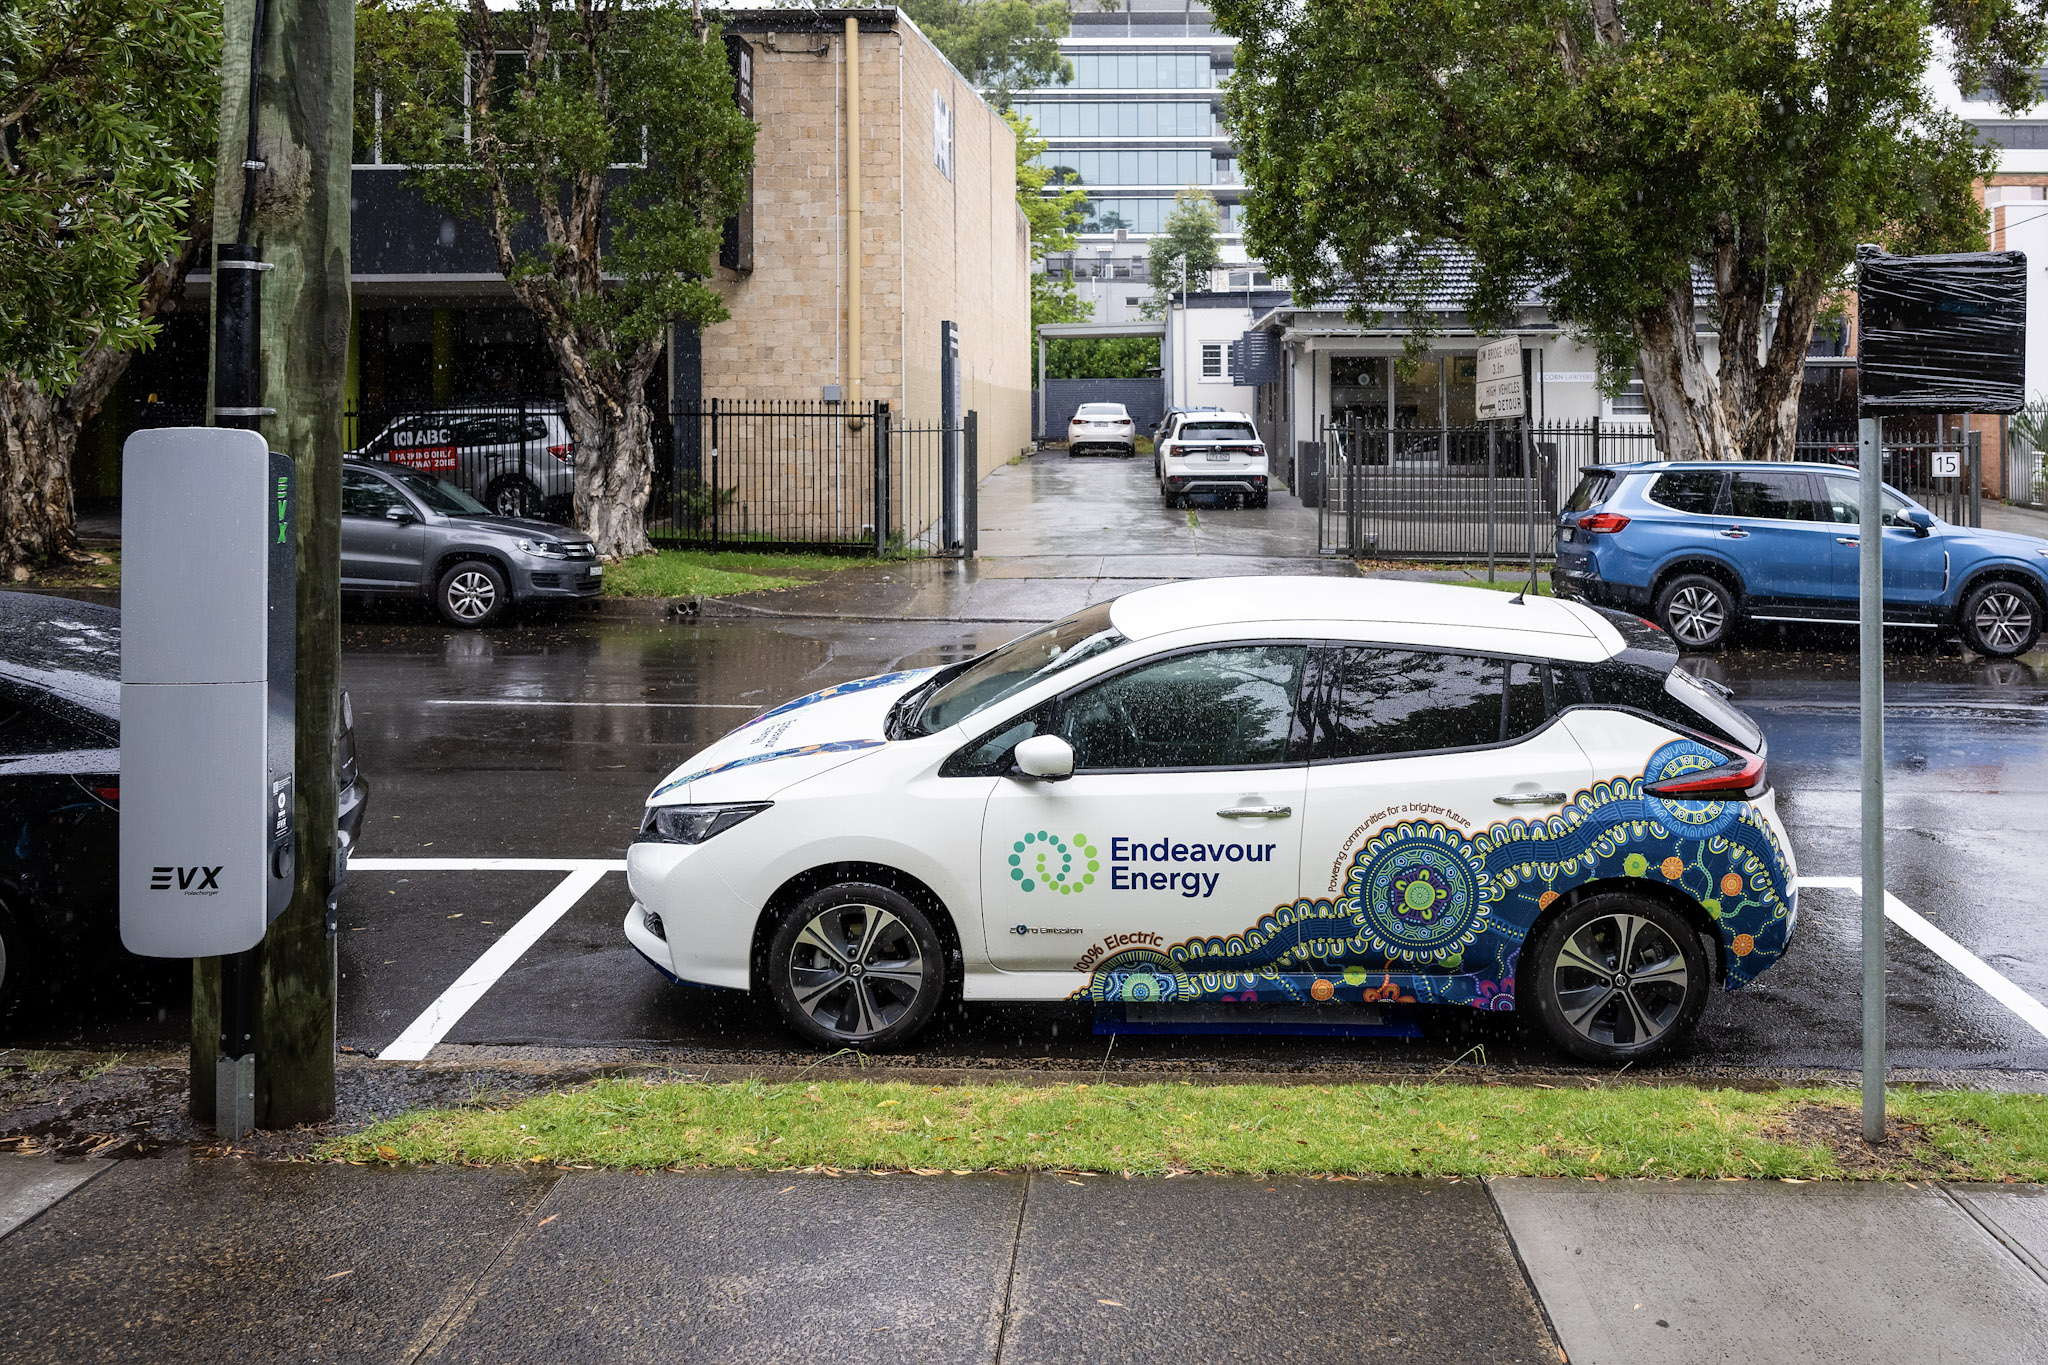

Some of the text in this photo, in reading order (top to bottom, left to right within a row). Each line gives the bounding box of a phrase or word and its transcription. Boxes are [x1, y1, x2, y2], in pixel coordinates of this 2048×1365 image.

[1487, 346, 1502, 360] BRIDGE
[1504, 342, 1519, 357] AHEAD
[1486, 381, 1520, 397] HIGH VEHICLES
[1498, 397, 1521, 411] DETOUR
[415, 429, 451, 446] ABC
[395, 450, 452, 461] PARKING ONLY
[434, 458, 456, 467] ZONE
[1936, 456, 1956, 473] 15
[277, 477, 288, 544] EVX
[1111, 837, 1276, 862] Endeavour
[1328, 802, 1471, 893] Powering communities for a brighter future
[150, 866, 224, 890] EVX
[1111, 866, 1220, 898] Energy
[1040, 927, 1084, 935] Emission
[1073, 931, 1164, 974] 100% Electric
